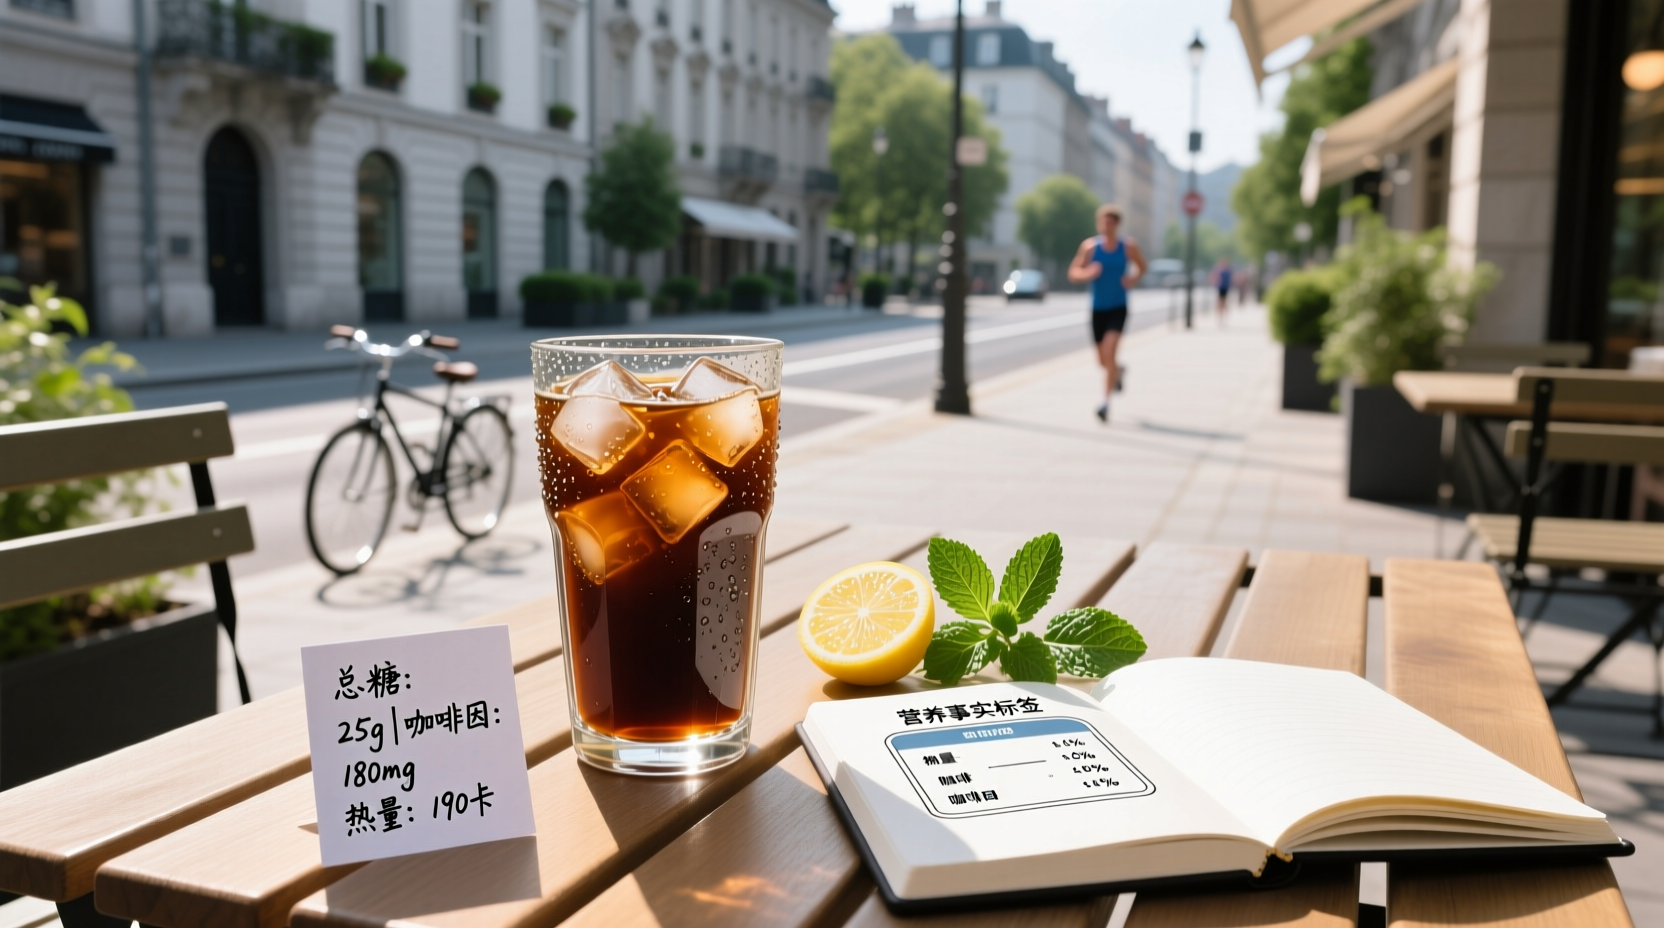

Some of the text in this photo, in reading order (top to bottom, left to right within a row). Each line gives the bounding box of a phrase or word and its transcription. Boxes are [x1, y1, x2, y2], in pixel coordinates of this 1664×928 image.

[334, 661, 412, 700] 总糖:
[896, 697, 1044, 726] 营养事实标签
[344, 760, 415, 792] 180mg
[432, 782, 495, 821] 190卡
